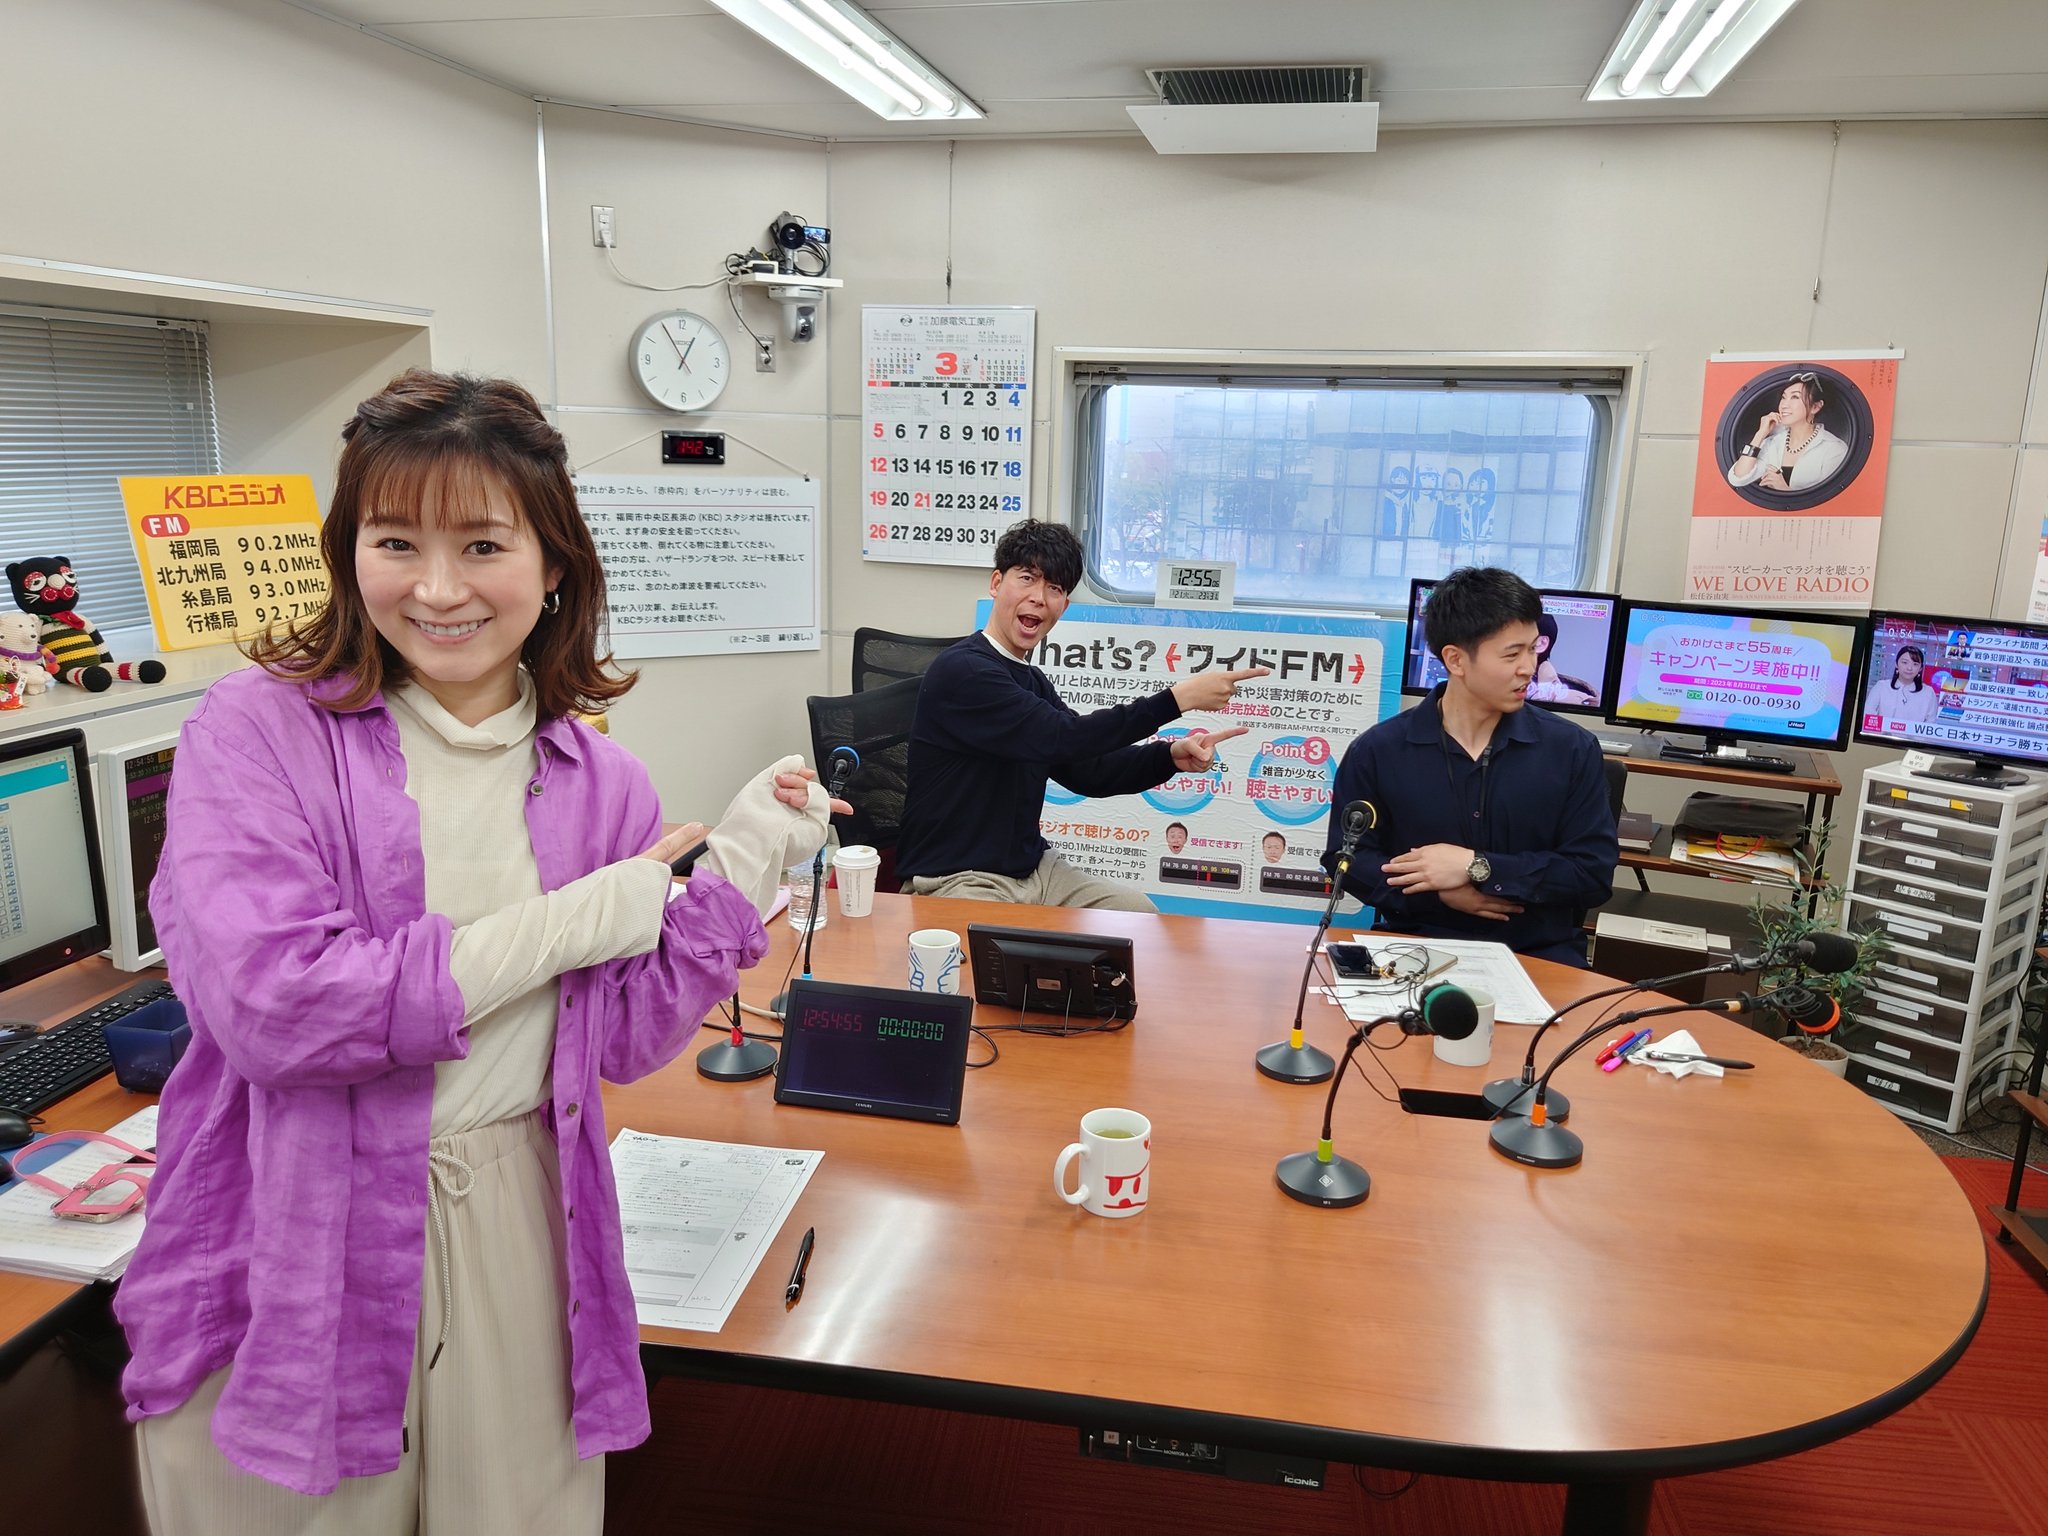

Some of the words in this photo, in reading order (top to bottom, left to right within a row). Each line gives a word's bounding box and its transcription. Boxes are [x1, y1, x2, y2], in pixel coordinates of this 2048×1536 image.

[678, 319, 687, 331] 12
[644, 354, 651, 366] 9
[713, 357, 720, 369] 3
[935, 352, 958, 376] 3
[680, 392, 687, 403] 6
[942, 390, 948, 404] 1
[964, 391, 974, 405] 2
[986, 392, 996, 406] 3
[1009, 392, 1020, 406] 4
[873, 423, 884, 438] 5
[895, 424, 905, 438] 6
[918, 425, 928, 439] 7
[940, 425, 950, 440] 8
[962, 426, 973, 440] 9
[982, 427, 999, 441] 10
[1006, 427, 1021, 442] 11
[871, 458, 887, 472] 12
[892, 458, 908, 472] 13
[914, 459, 931, 473] 14
[936, 460, 953, 474] 15
[958, 460, 975, 475] 16
[981, 461, 998, 475] 17
[1004, 462, 1021, 477] 18
[164, 483, 286, 509] KBCラジオ
[870, 491, 887, 505] 19
[891, 492, 909, 506] 20
[914, 493, 930, 507] 21
[935, 493, 953, 508] 22
[958, 495, 975, 509] 23
[980, 495, 998, 510] 24
[1002, 496, 1020, 511] 25
[148, 516, 183, 535] FM
[870, 524, 887, 539] 26
[891, 525, 909, 539] 27
[913, 526, 930, 540] 28
[935, 527, 953, 542] 29
[957, 528, 975, 543] 30
[980, 529, 996, 544] 31
[169, 538, 220, 560] 福岡局
[237, 533, 316, 553] 90.2MHz
[157, 562, 227, 586] 北九州局
[244, 556, 322, 576] 94.0MHz
[1178, 569, 1212, 587] 12:55
[181, 586, 233, 609] 糸島局
[249, 578, 327, 600] 93.0MHz
[1693, 576, 1724, 592] WE
[1733, 576, 1787, 592] LOVE
[1796, 577, 1870, 593] RADIO
[609, 602, 718, 613] 報が入り次第、お伝えします。
[186, 610, 238, 634] 行橋局
[1888, 627, 1913, 639] 0:54
[1680, 637, 1793, 656] おかげさまで55周年
[1976, 636, 2039, 650] ウクライナ訪問
[1027, 637, 1157, 672] hat's?
[1186, 643, 1344, 684] ワイドFM
[1650, 651, 1820, 682] キャンペーン実施中!!
[1974, 652, 2030, 665] 戦争犯罪追及へ
[1970, 683, 2016, 696] 国連安保理
[1706, 691, 1801, 710] 0120-00-0930
[1965, 713, 2025, 729] 少子化対策強化
[1914, 723, 1943, 737] WBC
[1947, 729, 2048, 752] 日本サヨナラ勝ち
[1261, 742, 1305, 760] Point
[1308, 740, 1323, 759] 3
[1262, 765, 1326, 780] 雑音が少なく
[1190, 837, 1243, 850] 受信できます!
[1287, 846, 1323, 857] 受信でき
[1081, 867, 1145, 881] 売されています。
[803, 1008, 863, 1033] 12:54:55
[878, 1016, 944, 1041] 00:00:00
